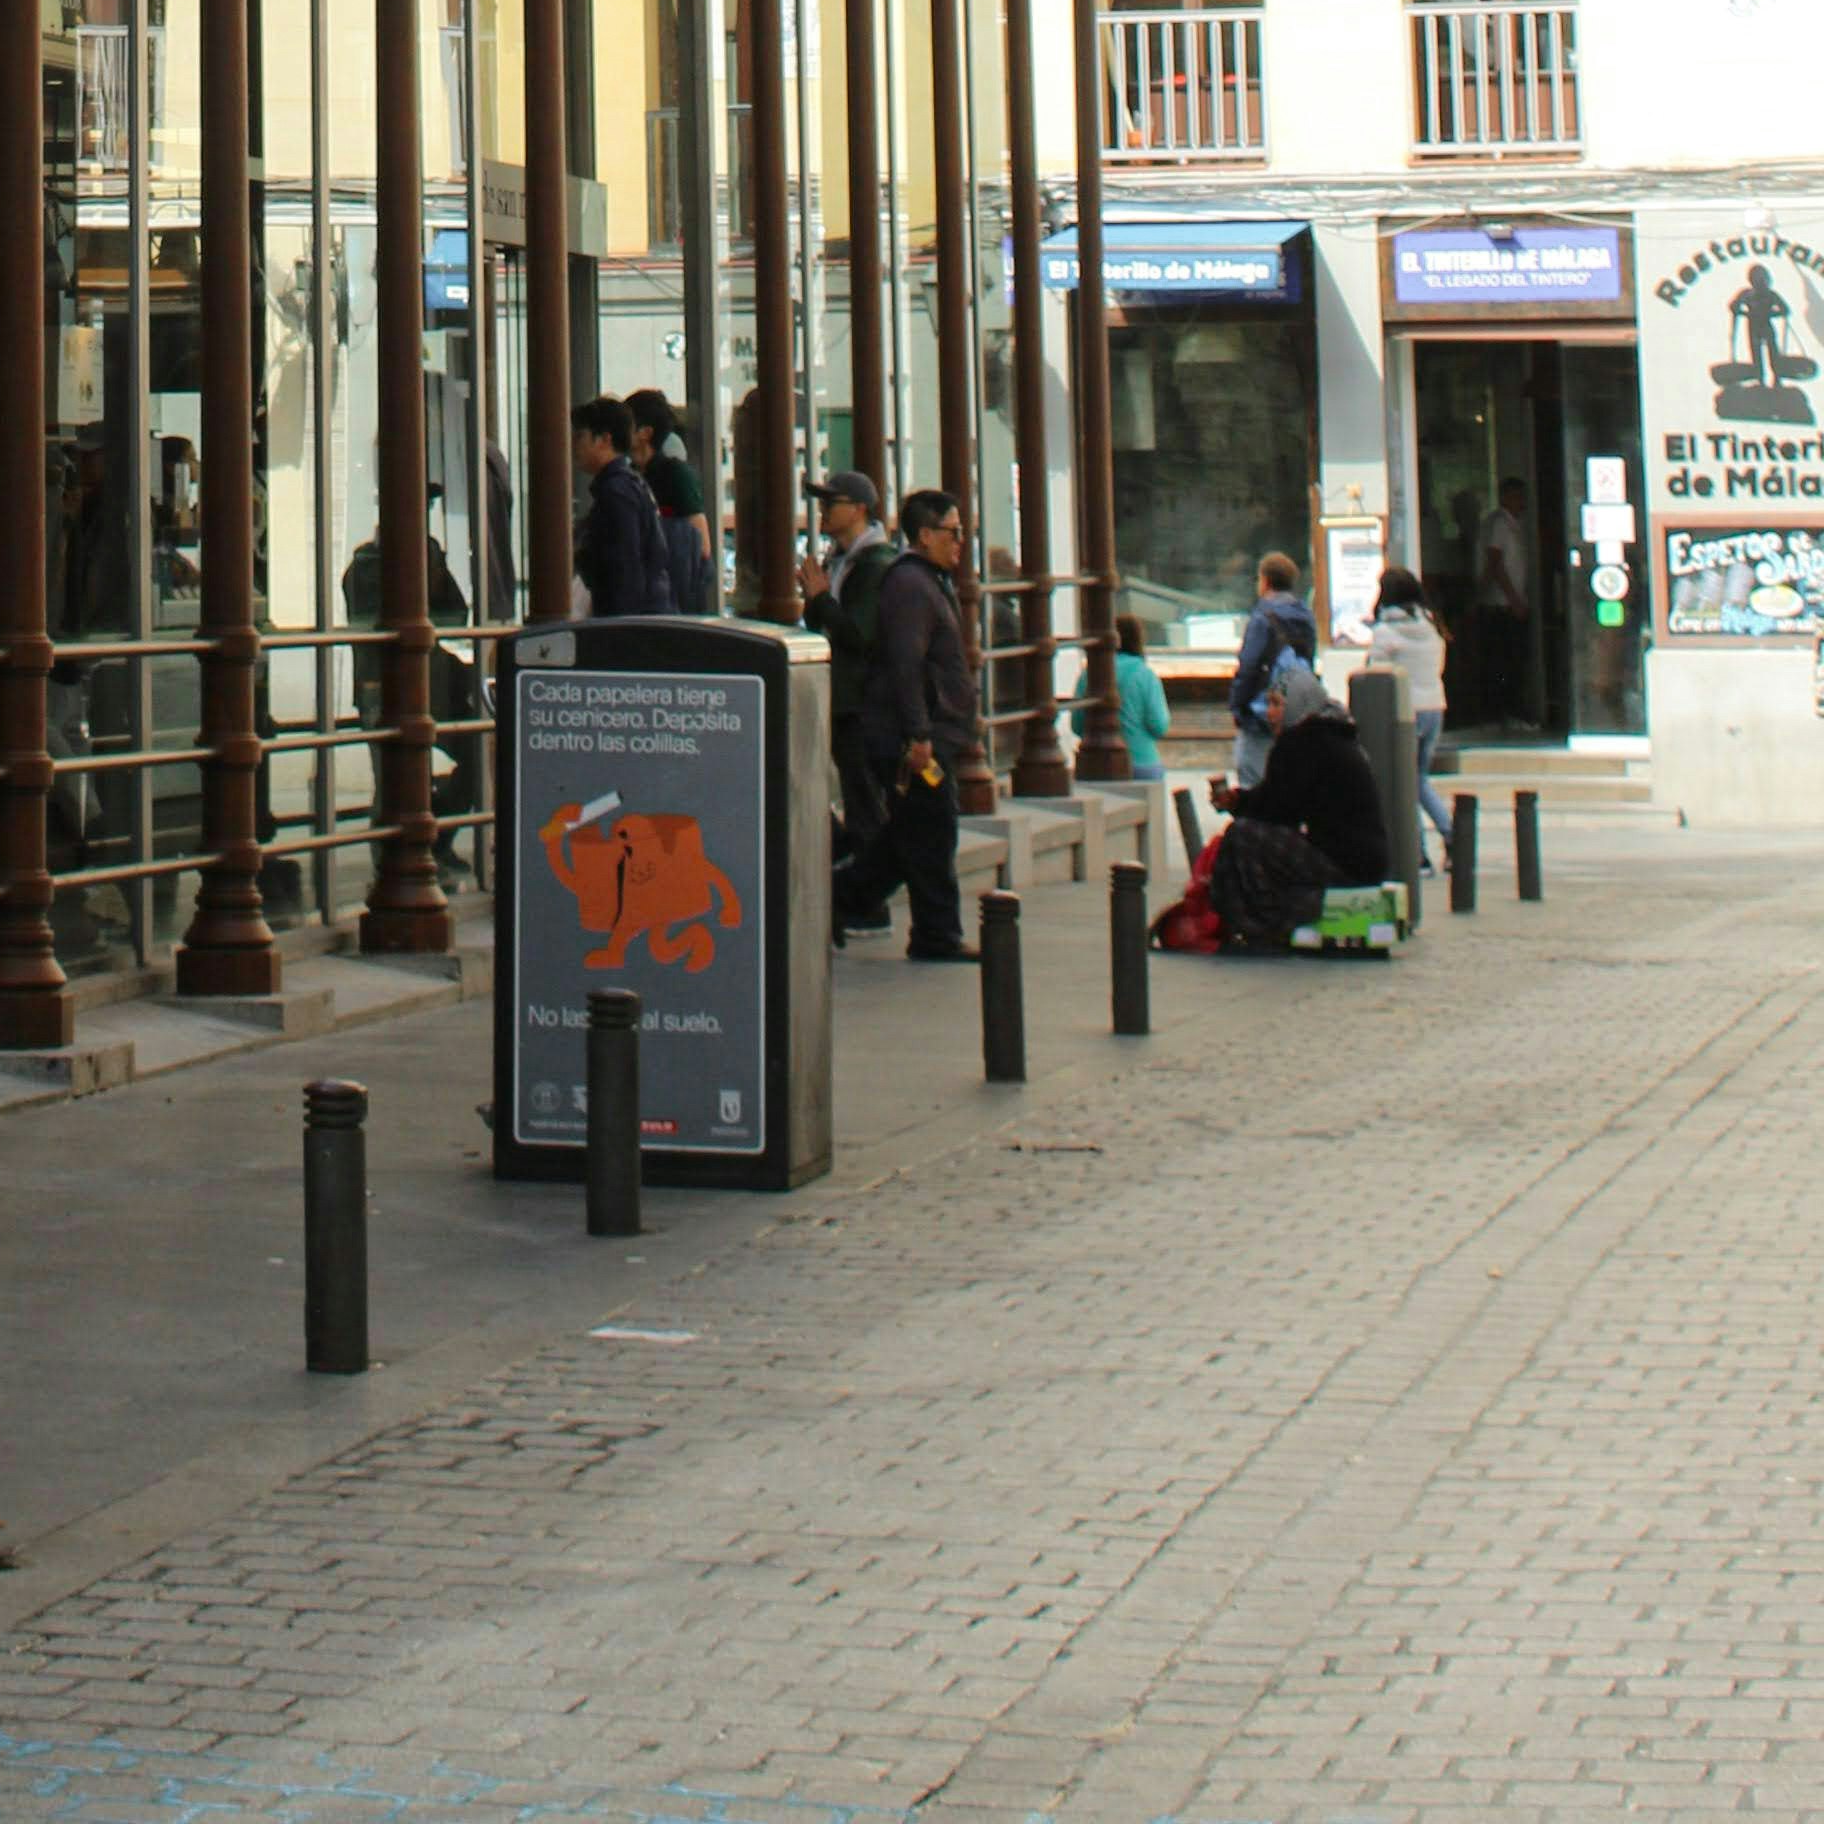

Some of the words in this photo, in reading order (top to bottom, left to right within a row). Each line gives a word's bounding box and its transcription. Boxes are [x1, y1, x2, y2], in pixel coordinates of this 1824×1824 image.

[1165, 261, 1190, 281] de
[1194, 259, 1269, 285] Málaga
[1447, 273, 1499, 288] LEGADO
[1502, 273, 1528, 287] DEL
[1664, 432, 1697, 462] El
[1667, 468, 1714, 499] de
[529, 680, 582, 703] Cada
[586, 683, 673, 706] papelera
[676, 685, 727, 707] tiene
[529, 710, 553, 727] su
[557, 709, 647, 729] cenicero.
[529, 731, 594, 752] dentro
[598, 732, 626, 752] las
[630, 733, 701, 755] colillas.
[528, 1005, 559, 1026] No
[642, 1010, 660, 1032] al
[664, 1011, 723, 1034] suelo.
